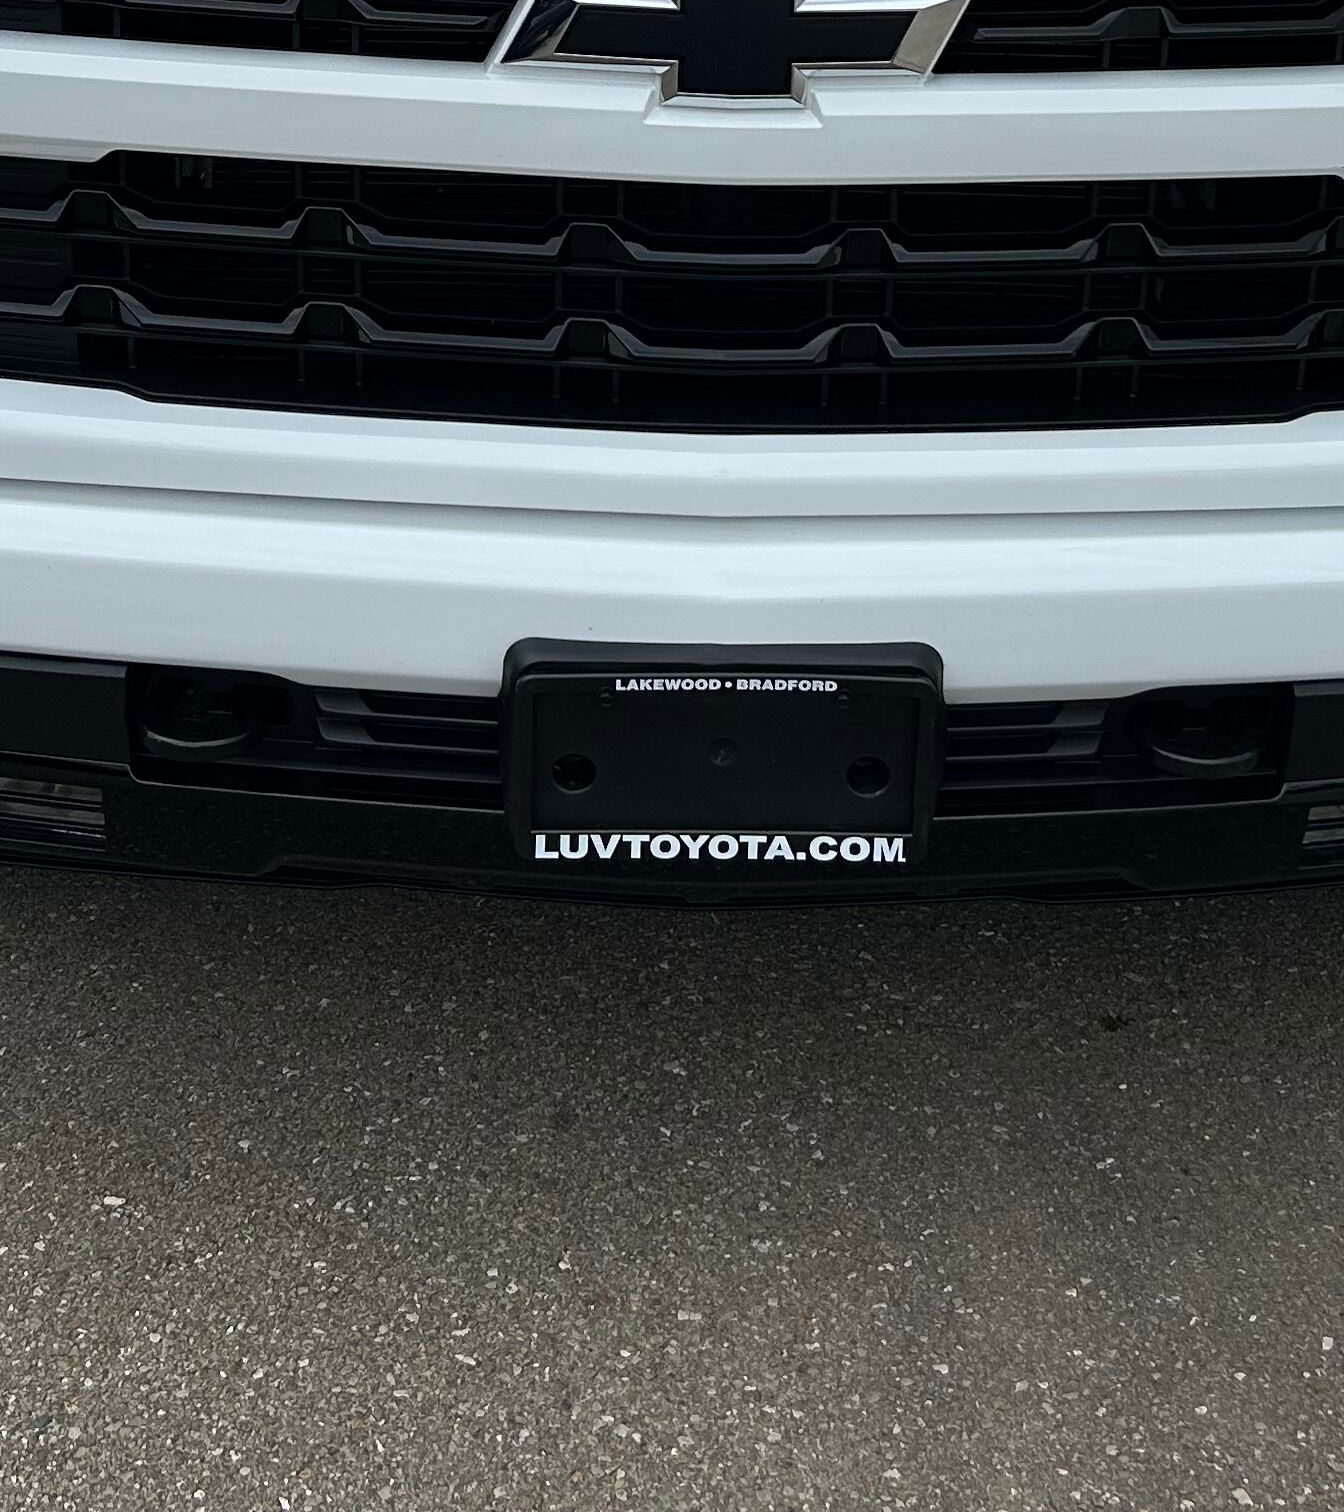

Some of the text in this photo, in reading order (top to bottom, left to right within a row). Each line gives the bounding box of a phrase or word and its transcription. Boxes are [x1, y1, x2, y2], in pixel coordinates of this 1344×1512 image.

[614, 678, 839, 693] LAKEWOOD BRADFORD
[534, 833, 907, 863] LUVTOYOTA.COM
